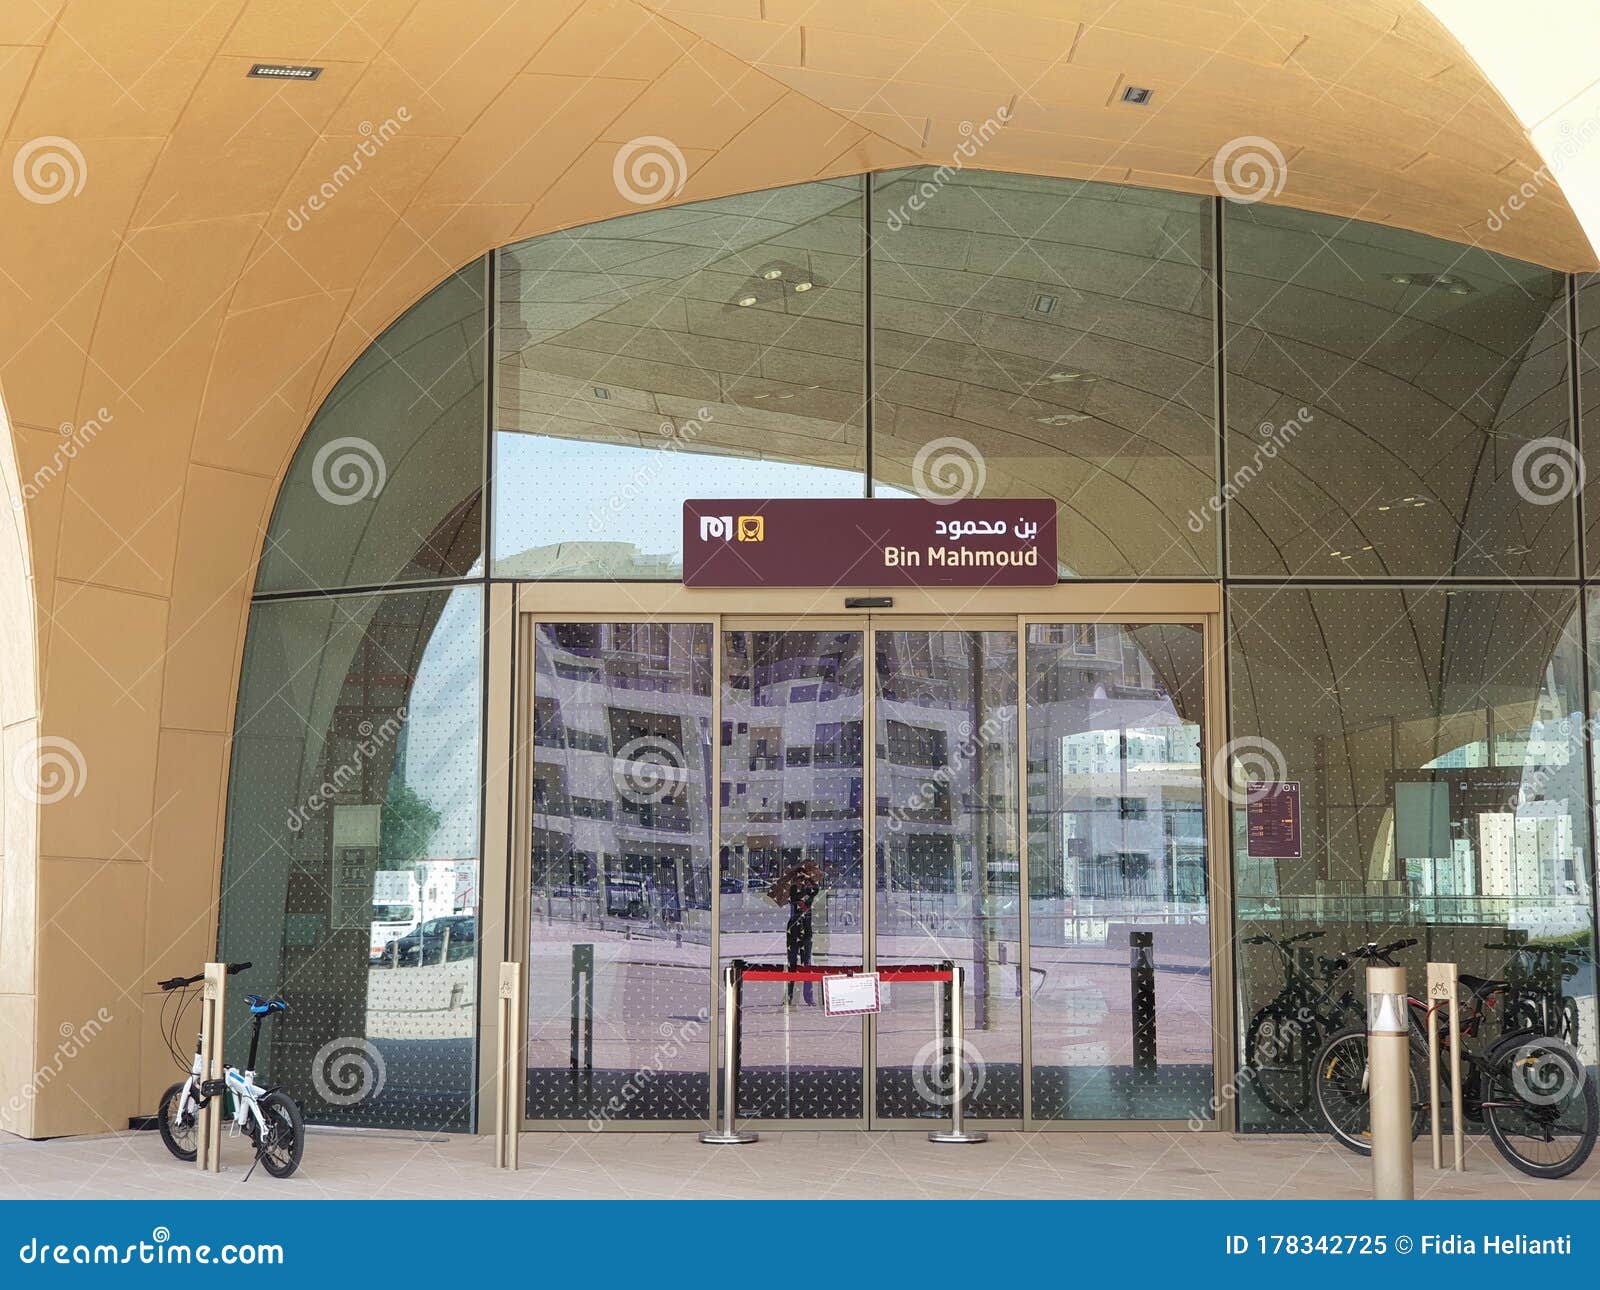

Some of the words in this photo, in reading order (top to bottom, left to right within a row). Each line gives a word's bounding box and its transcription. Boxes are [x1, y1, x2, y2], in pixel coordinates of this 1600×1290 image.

[935, 517, 1007, 540] محمود
[1014, 517, 1037, 539] بن
[884, 546, 920, 567] Bin
[929, 546, 1037, 567] Mahmoud
